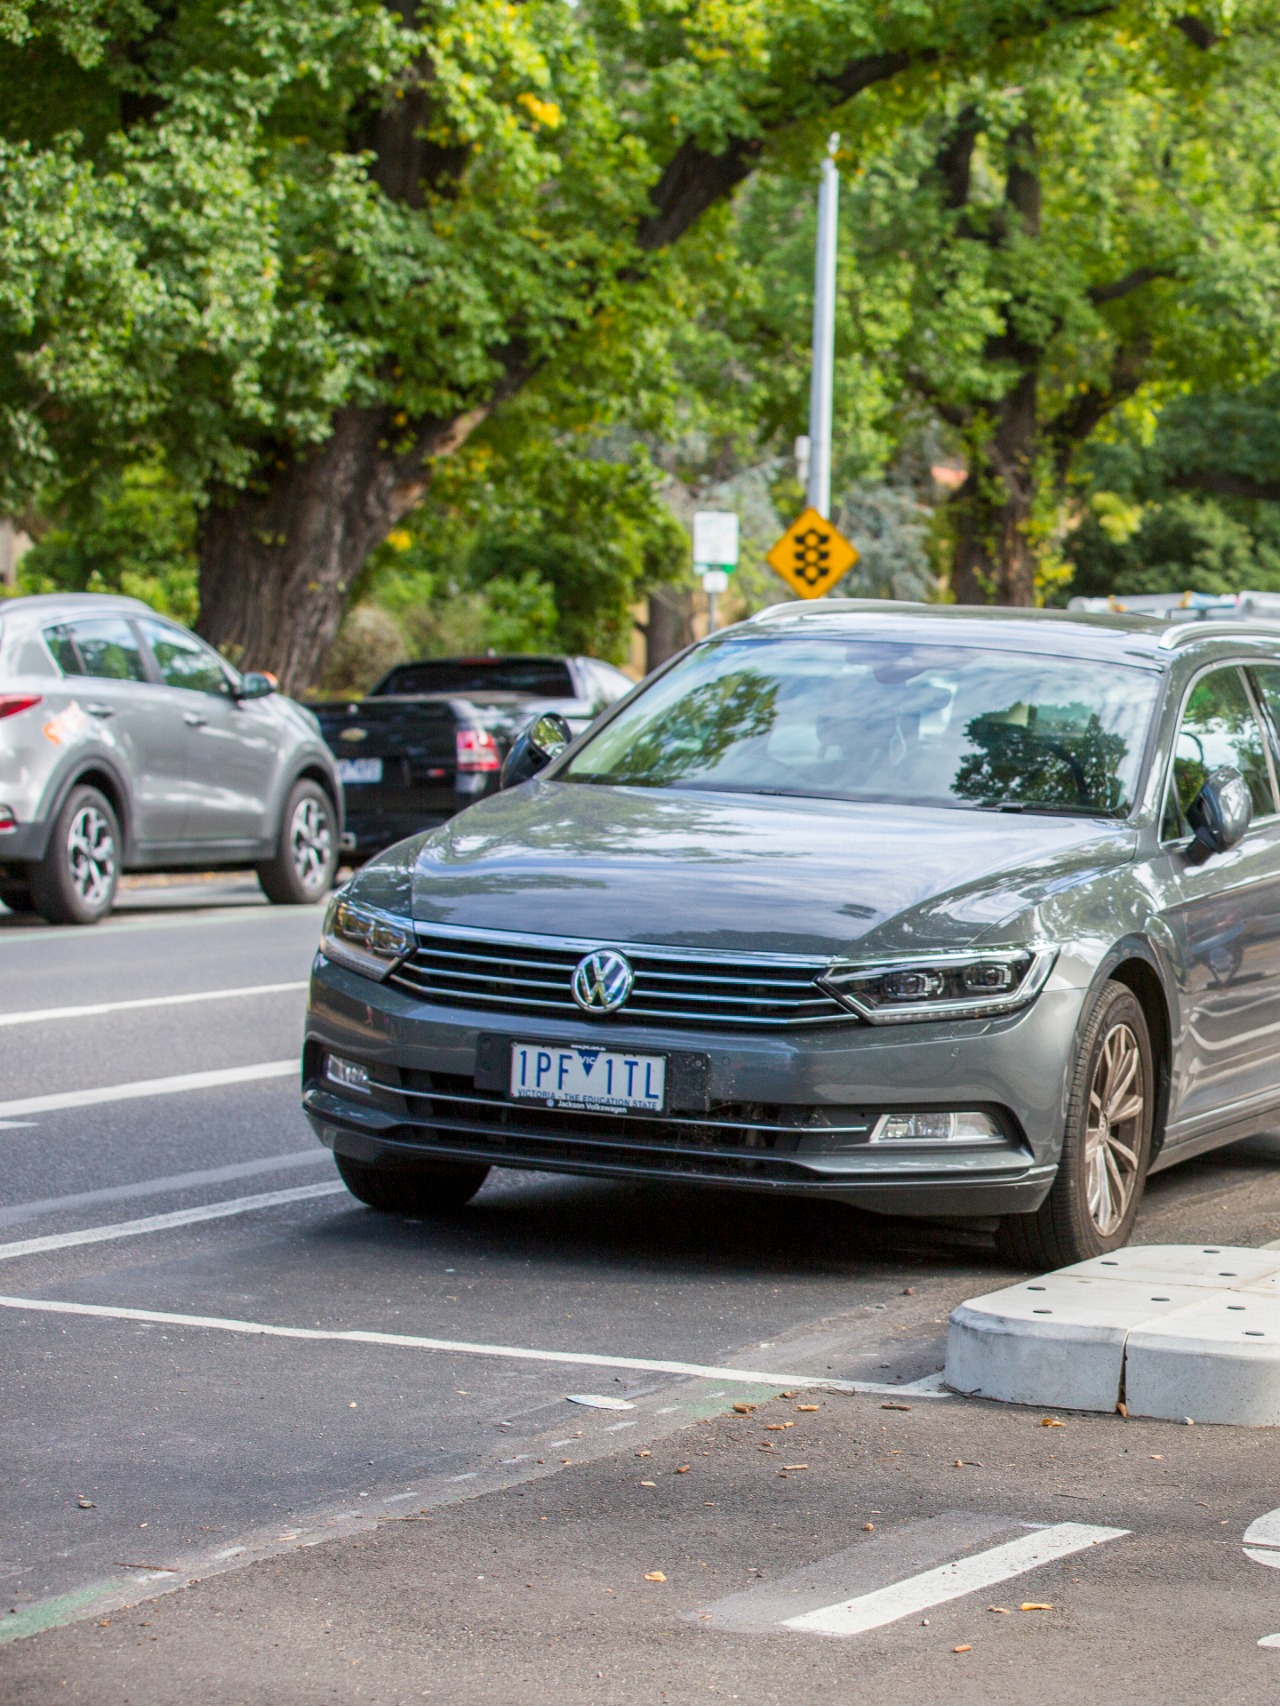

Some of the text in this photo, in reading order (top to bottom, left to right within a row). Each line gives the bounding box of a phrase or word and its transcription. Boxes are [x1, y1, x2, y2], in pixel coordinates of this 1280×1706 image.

[580, 1055, 596, 1064] VIC
[520, 1050, 659, 1099] 1PF 1TL
[517, 1089, 555, 1100] VICTORIA
[564, 1093, 579, 1102] THE
[582, 1095, 629, 1107] EDUCATION
[632, 1100, 657, 1110] STATE
[558, 1100, 628, 1114] Jackson Volkswagen
